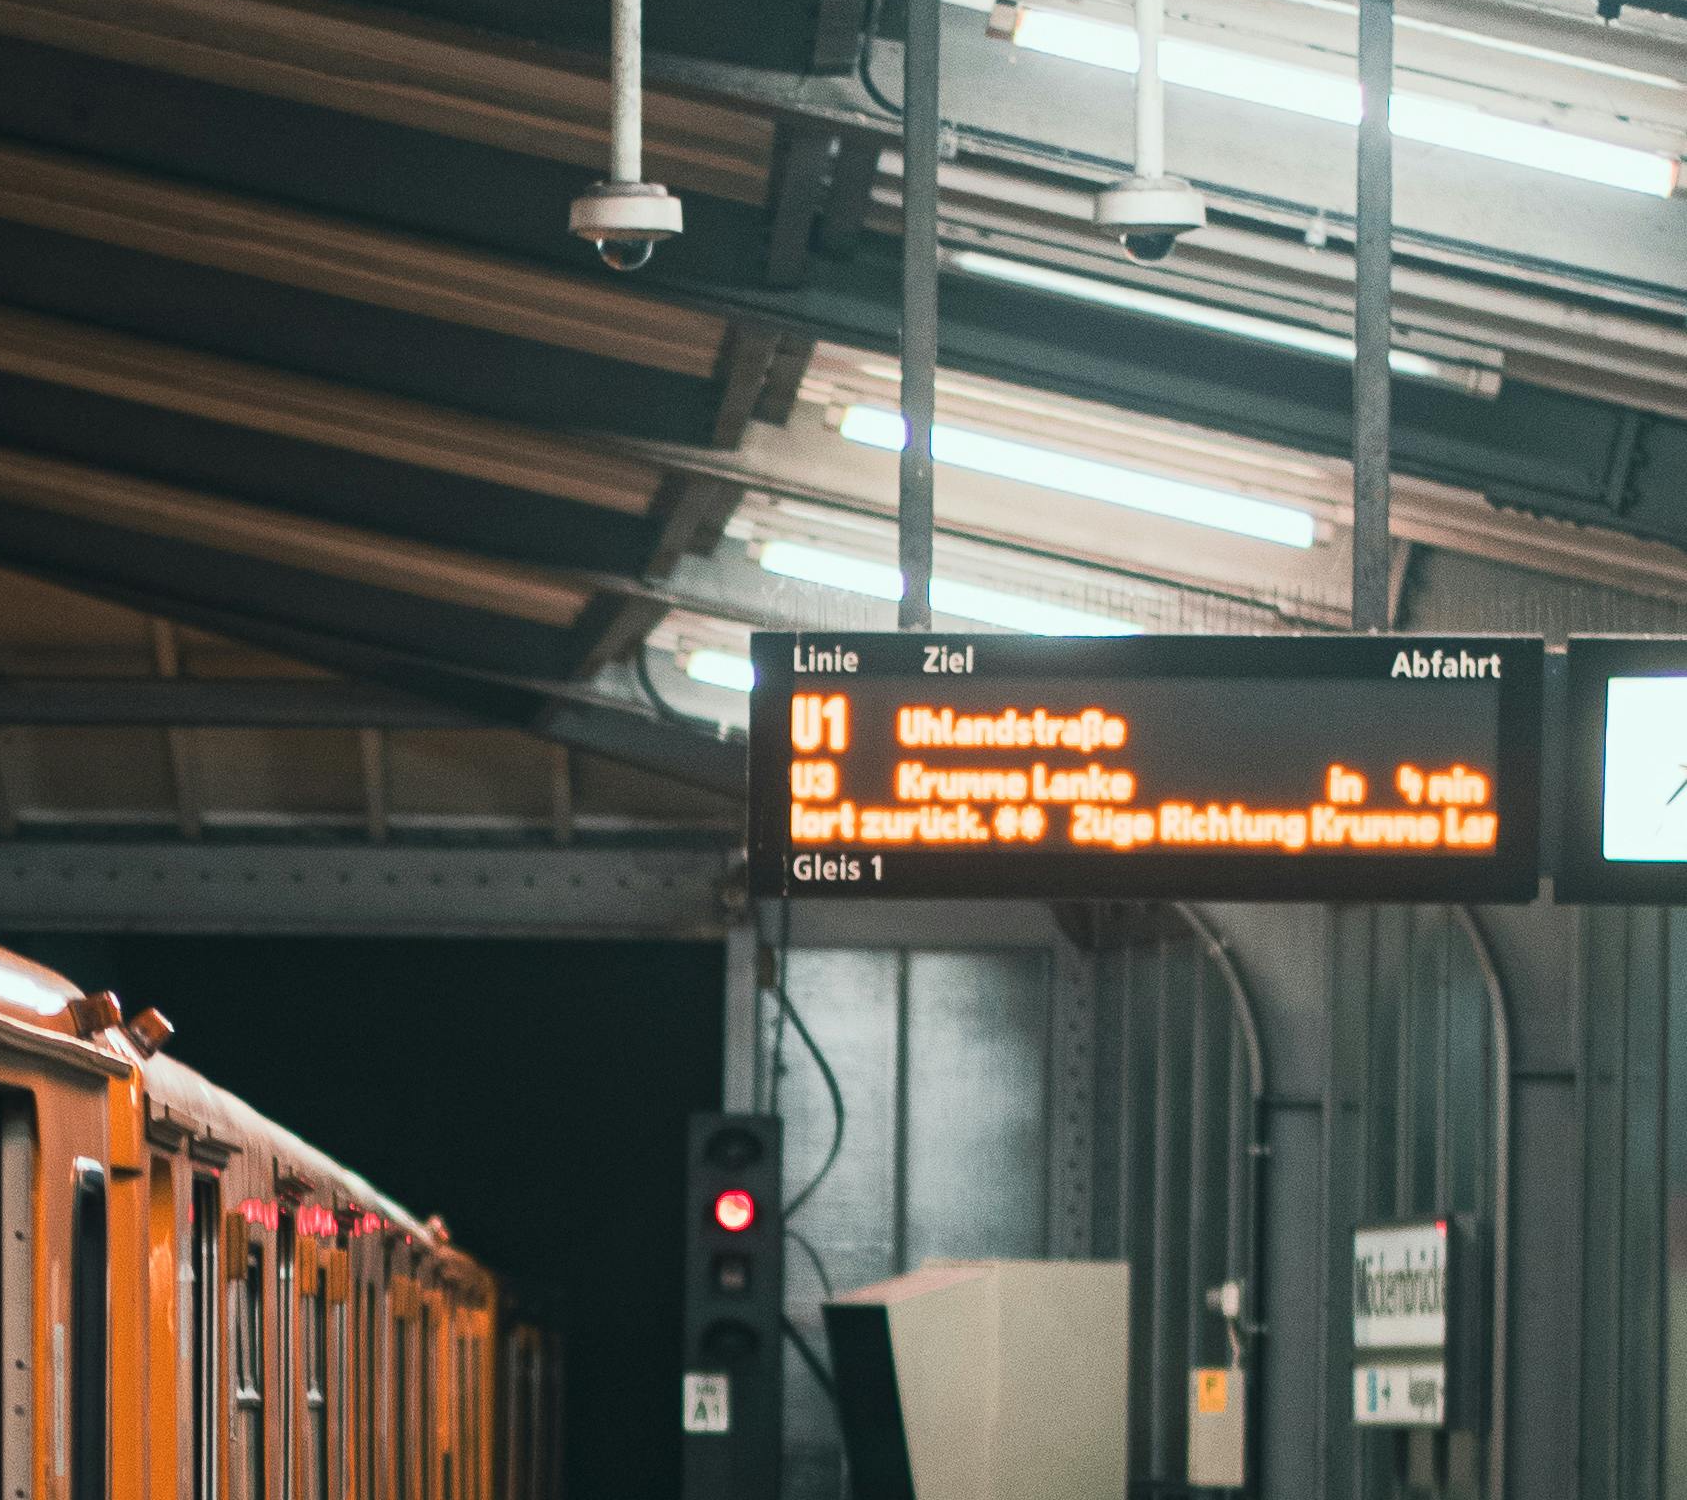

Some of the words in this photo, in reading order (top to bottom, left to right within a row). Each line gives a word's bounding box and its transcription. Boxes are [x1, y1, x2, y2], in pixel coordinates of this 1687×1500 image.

[793, 644, 859, 674] Linie
[922, 645, 974, 674] Ziel
[1391, 650, 1502, 679] Abfahrt
[791, 694, 849, 752] U1
[897, 706, 1127, 752] Uhlandstraße
[791, 760, 838, 800] U3
[1031, 762, 1135, 802] Lanke
[1327, 765, 1365, 804] in
[859, 803, 990, 842] zurück.
[1070, 803, 1156, 848] Züge
[1158, 803, 1309, 849] Richtung
[792, 854, 861, 881] Gleis
[870, 855, 883, 881] 1
